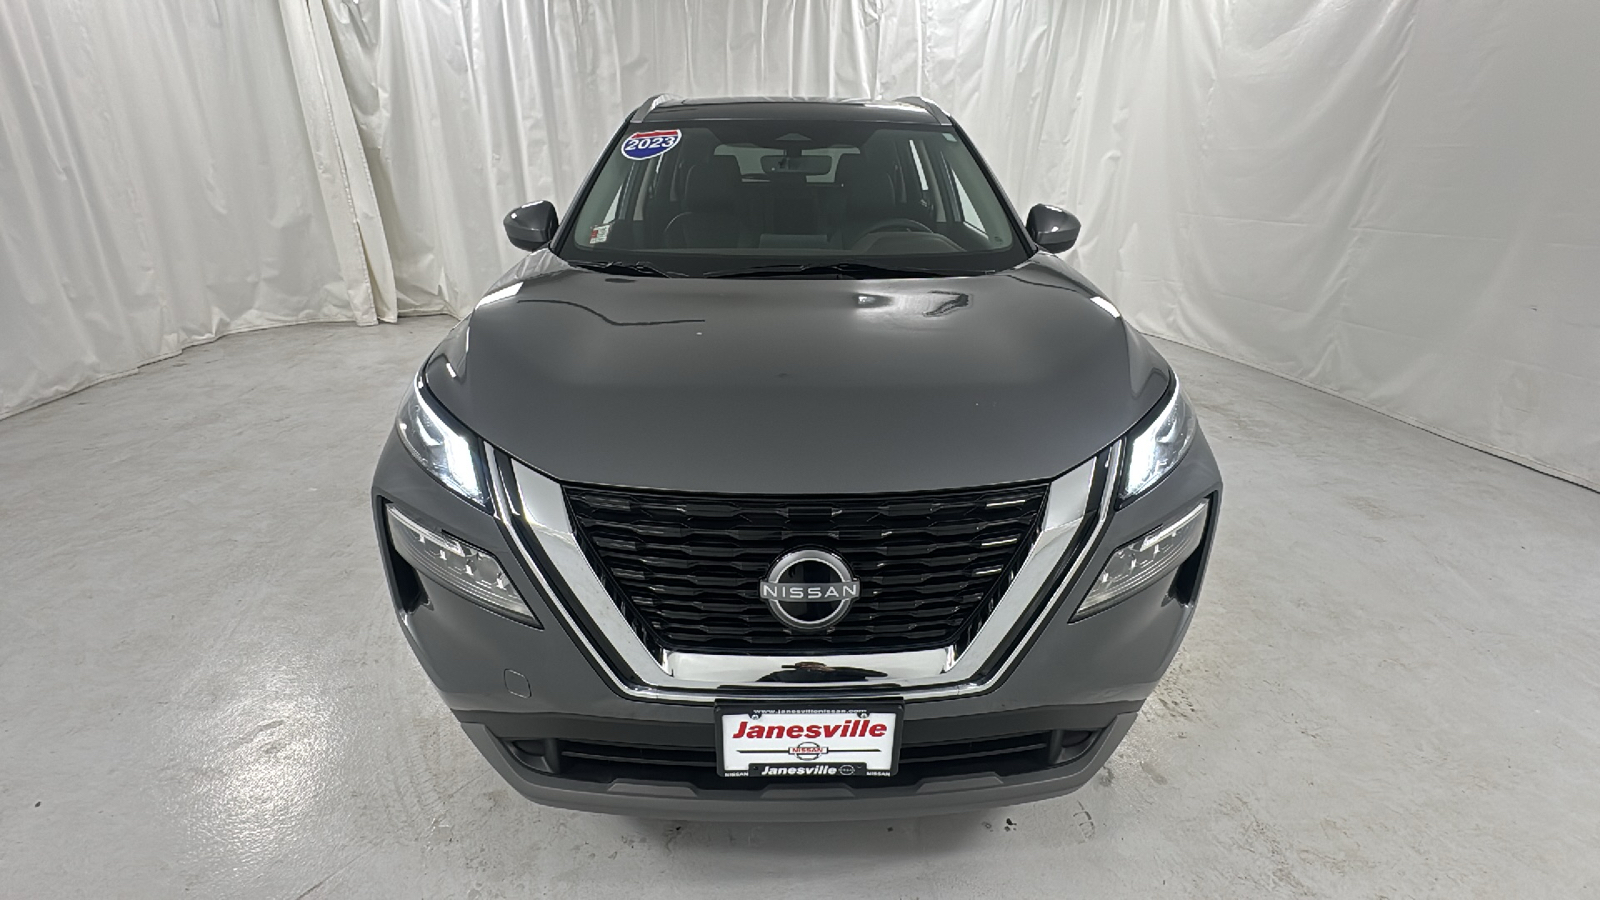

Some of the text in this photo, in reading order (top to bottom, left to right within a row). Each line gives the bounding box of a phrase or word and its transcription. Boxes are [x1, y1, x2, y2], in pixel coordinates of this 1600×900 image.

[625, 137, 676, 150] 2023
[763, 584, 857, 599] NISSAN
[732, 720, 887, 739] Janesville
[761, 765, 837, 775] Janesville
